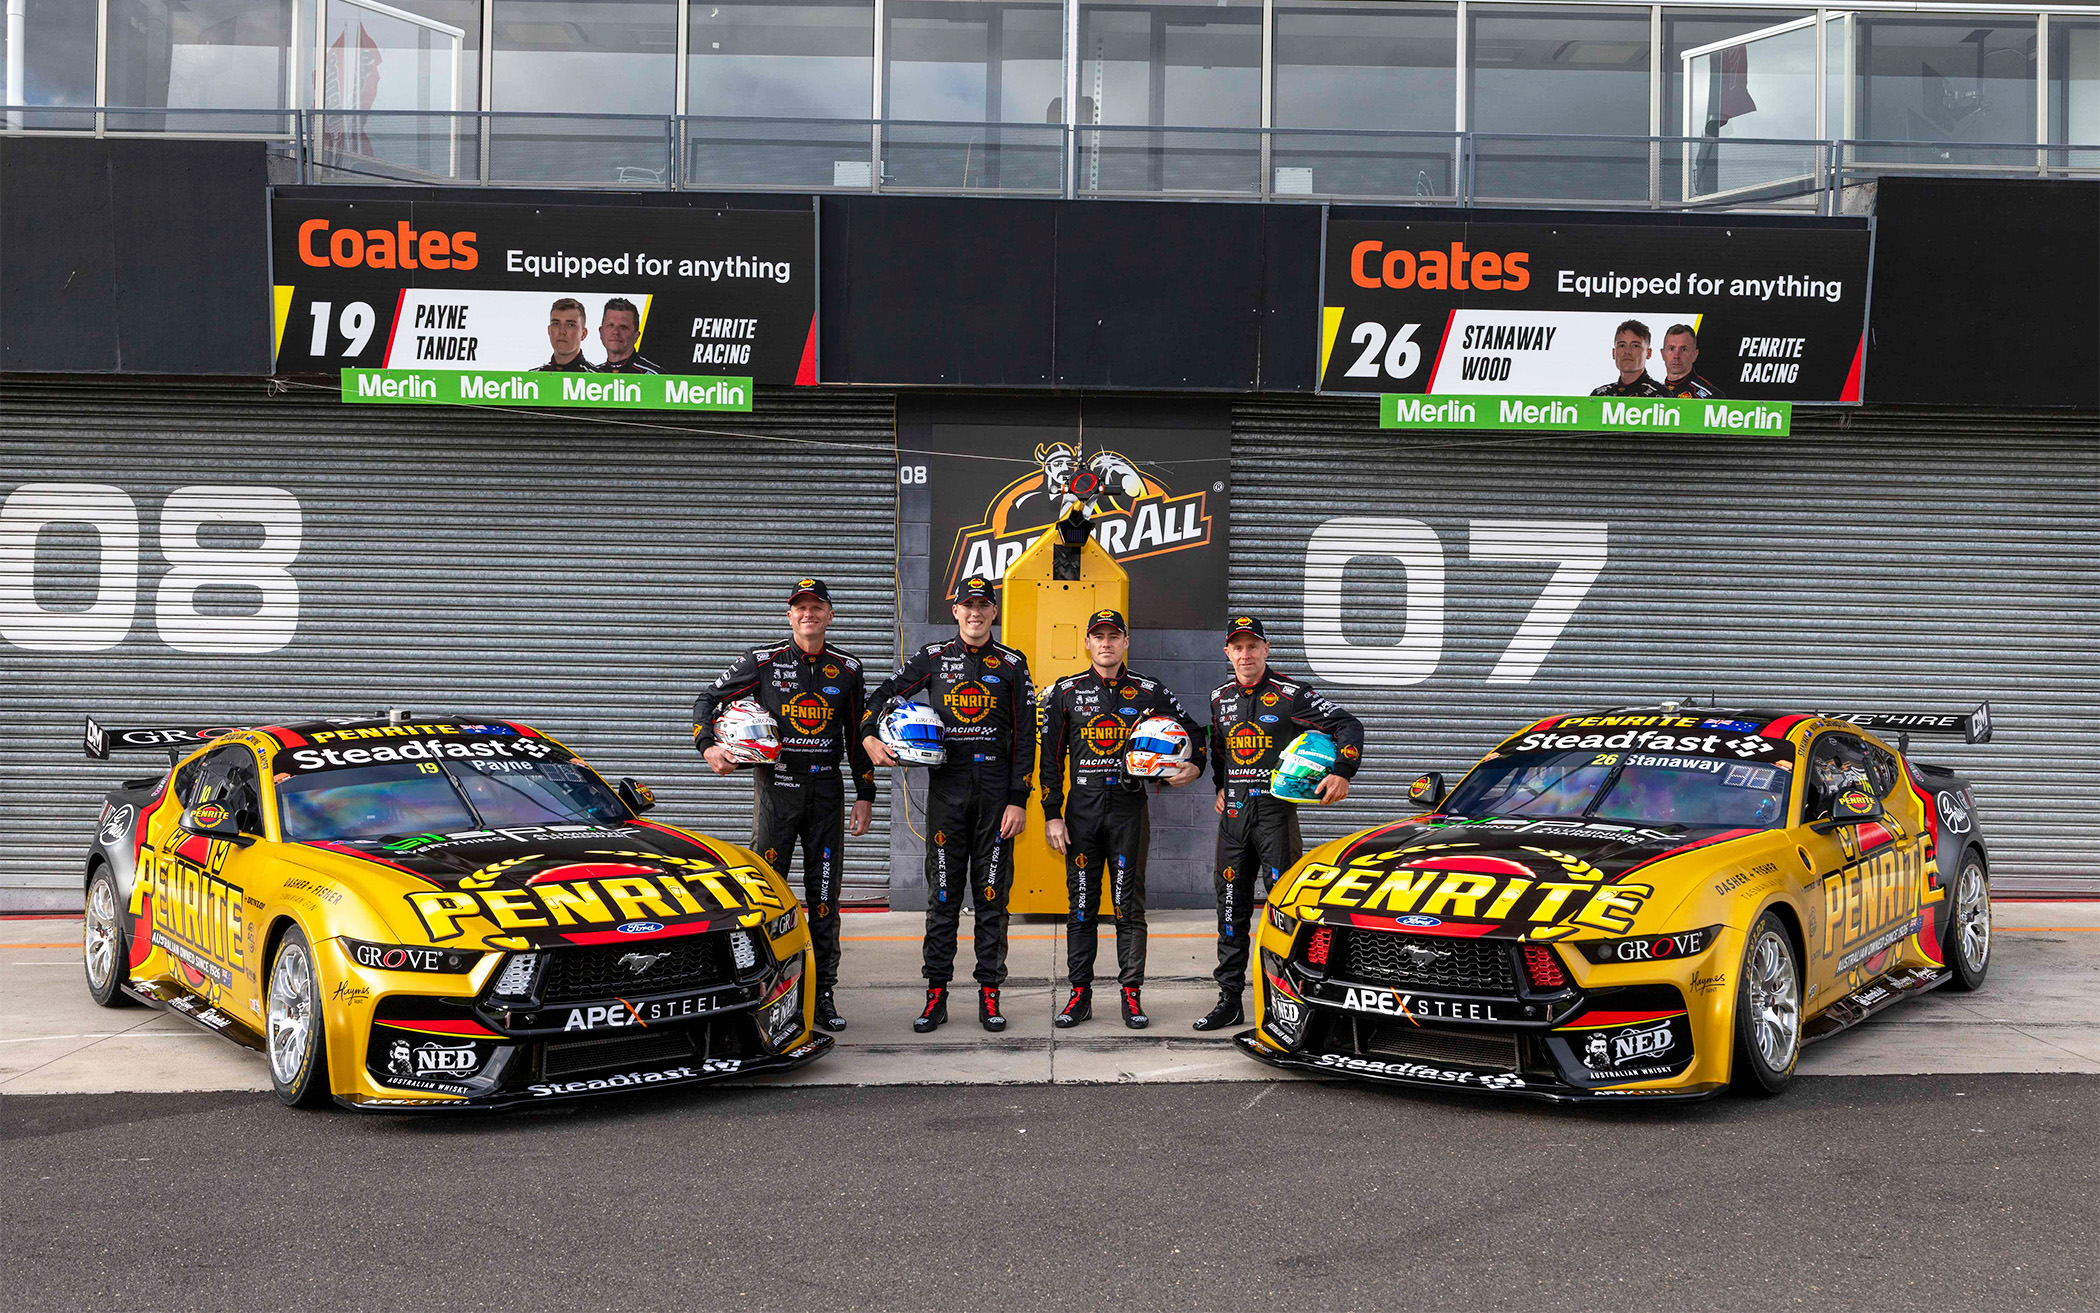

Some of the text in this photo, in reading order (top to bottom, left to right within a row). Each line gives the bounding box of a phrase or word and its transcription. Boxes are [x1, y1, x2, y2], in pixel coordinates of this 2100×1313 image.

[298, 219, 479, 270] Coates
[506, 249, 791, 284] Equipped for anything
[1350, 240, 1531, 291] Coates
[1557, 270, 1843, 302] Equipped for anything
[415, 304, 468, 330] PAYNE
[691, 317, 758, 339] PENRITE
[309, 302, 377, 358] 19
[1462, 324, 1557, 351] STANAWAY
[416, 336, 478, 361] TANDER
[692, 343, 752, 365] RACING
[1344, 322, 1422, 379] 26
[1738, 336, 1806, 358] PENRITE
[1461, 356, 1511, 381] WOOD
[1739, 362, 1800, 384] RACING
[357, 374, 744, 405] Merlin Merlin Merlin Merlin
[1397, 399, 1783, 430] Merlin Merlin Merlin Merlin
[900, 465, 927, 485] 08
[0, 483, 302, 653] 08
[1303, 517, 1608, 685] 07
[772, 680, 798, 689] GROVE
[781, 703, 834, 720] PENRITE
[944, 694, 997, 708] PENRITE
[945, 726, 981, 734] RACING
[1557, 715, 1700, 729] PENRITE
[1885, 714, 1958, 726] HIRE
[122, 726, 252, 745] GRO
[310, 724, 460, 744] PENRITE
[783, 737, 820, 746] RACING
[1225, 735, 1273, 750] PENRITE
[1515, 730, 1723, 753] Steadfast
[293, 740, 513, 770] Steadfast
[472, 759, 534, 775] Payne
[1079, 758, 1115, 766] RACING
[1591, 754, 1618, 767] 26
[1625, 753, 1727, 774] Stanaway
[415, 762, 439, 775] 19
[1838, 796, 1875, 806] PENRITE
[190, 809, 230, 820] PENRITE
[1540, 827, 1645, 842] ALUMINIUM
[1546, 831, 1640, 845] HARDWARE
[937, 848, 947, 887] SINCE 1926
[988, 846, 1001, 885] SINCE 1926
[1116, 869, 1124, 886] 1926
[820, 861, 831, 901] SINCE 1926
[1078, 870, 1086, 909] SINCE 1926
[1714, 872, 1750, 896] DASHER
[1752, 862, 1779, 876] FISHER
[311, 884, 343, 906] FISHER
[408, 866, 783, 942] PENRITE
[1225, 883, 1234, 922] SINCE 1926
[1282, 864, 1654, 935] PENRITE
[1824, 834, 1945, 957] PENRITE
[130, 845, 244, 972] PENRITE
[152, 931, 221, 980] AUSTRALIAN OWNED SINCE 1926
[357, 945, 439, 970] GROVE
[1617, 932, 1702, 961] GROVE
[1836, 945, 1870, 972] AUSTRALIAN
[1869, 938, 1885, 954] OWNED
[1884, 931, 1900, 948] SINCE
[333, 980, 370, 1006] Haymes
[1690, 971, 1726, 996] Haymes
[563, 997, 721, 1032] APEX STEEL
[1278, 1001, 1299, 1022] NED
[1342, 986, 1499, 1027] APEX STEEL
[1615, 1029, 1673, 1059] NED
[417, 1050, 477, 1070] NED
[1313, 1054, 1473, 1085] Steadfast
[387, 1077, 469, 1094] AUSTRALIAN WHISKY
[526, 1065, 696, 1098] Steadfast
[1590, 1066, 1673, 1080] AUSTRALIAN WHISKY
